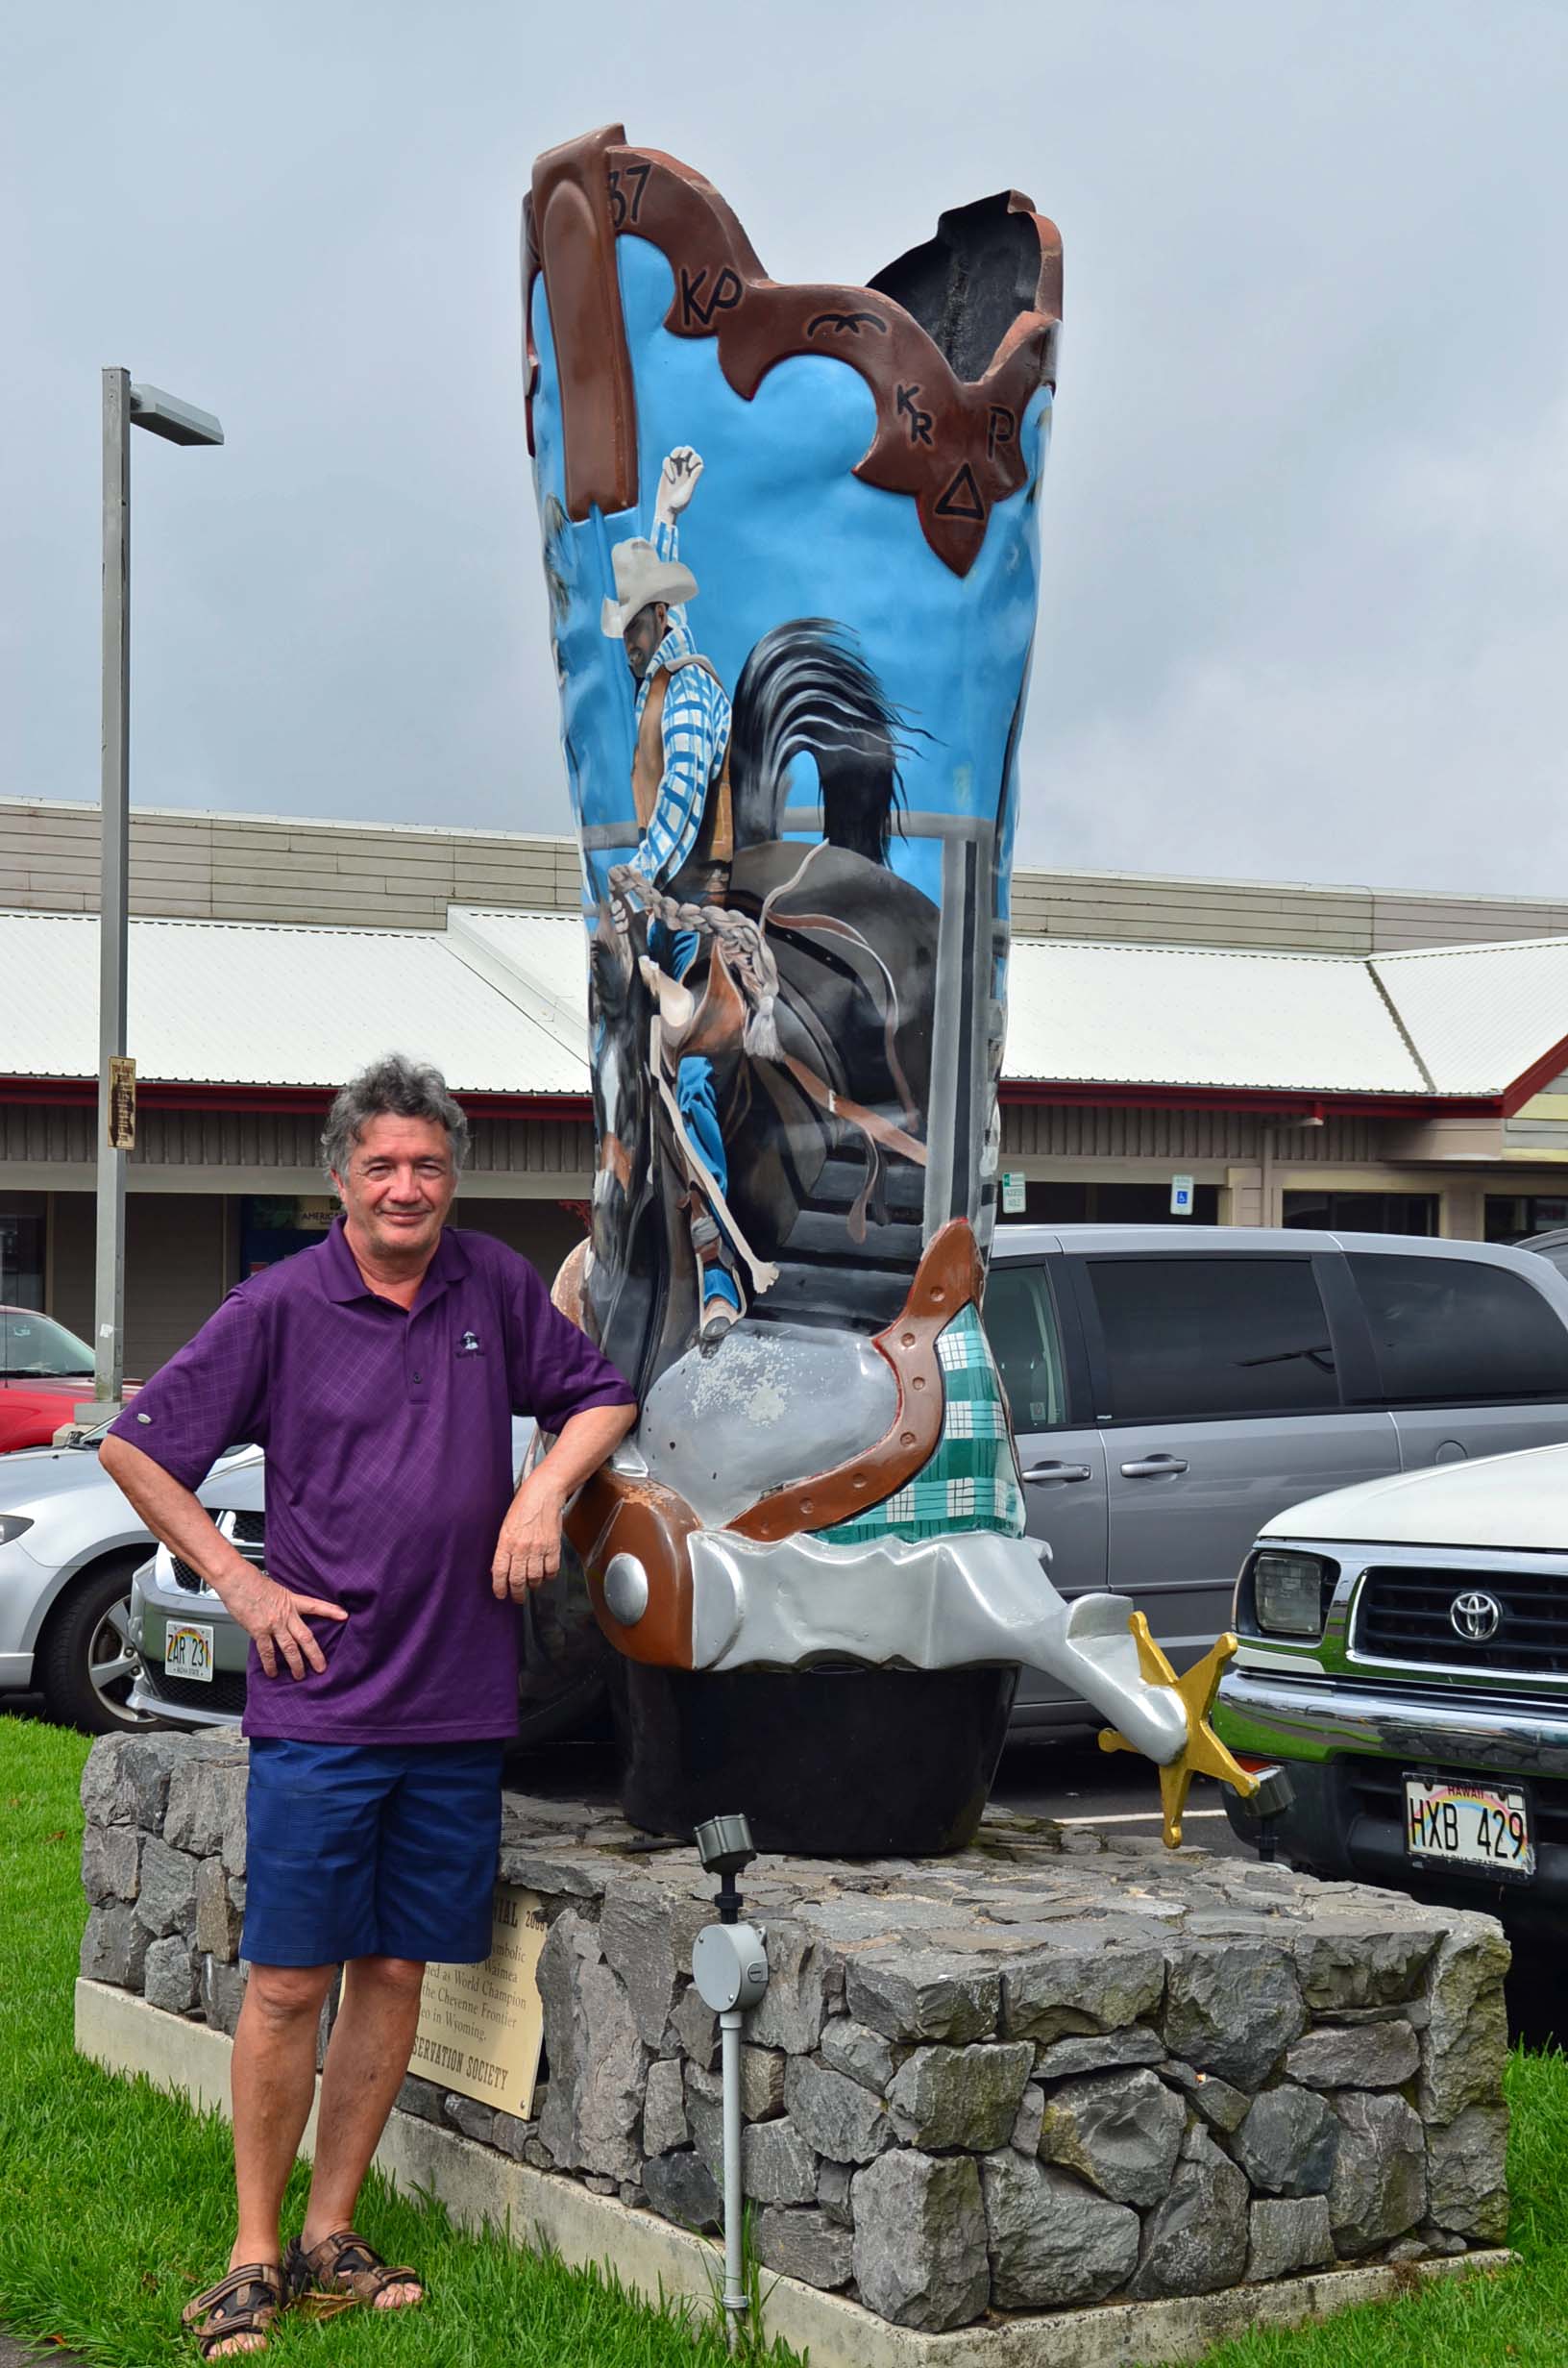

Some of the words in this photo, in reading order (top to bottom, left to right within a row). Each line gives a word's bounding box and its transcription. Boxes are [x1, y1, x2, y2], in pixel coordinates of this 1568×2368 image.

[680, 267, 744, 326] KP
[989, 406, 1015, 458] P
[167, 1634, 186, 1665] ZAR
[192, 1638, 209, 1668] 231
[1409, 1797, 1459, 1852] HXB
[1477, 1807, 1524, 1860] 429
[438, 1986, 478, 2015] Cheyenne
[481, 2002, 518, 2029] Frontier
[454, 1968, 479, 1992] World
[481, 1980, 527, 2010] Champion
[466, 2055, 509, 2090] SOCIETY
